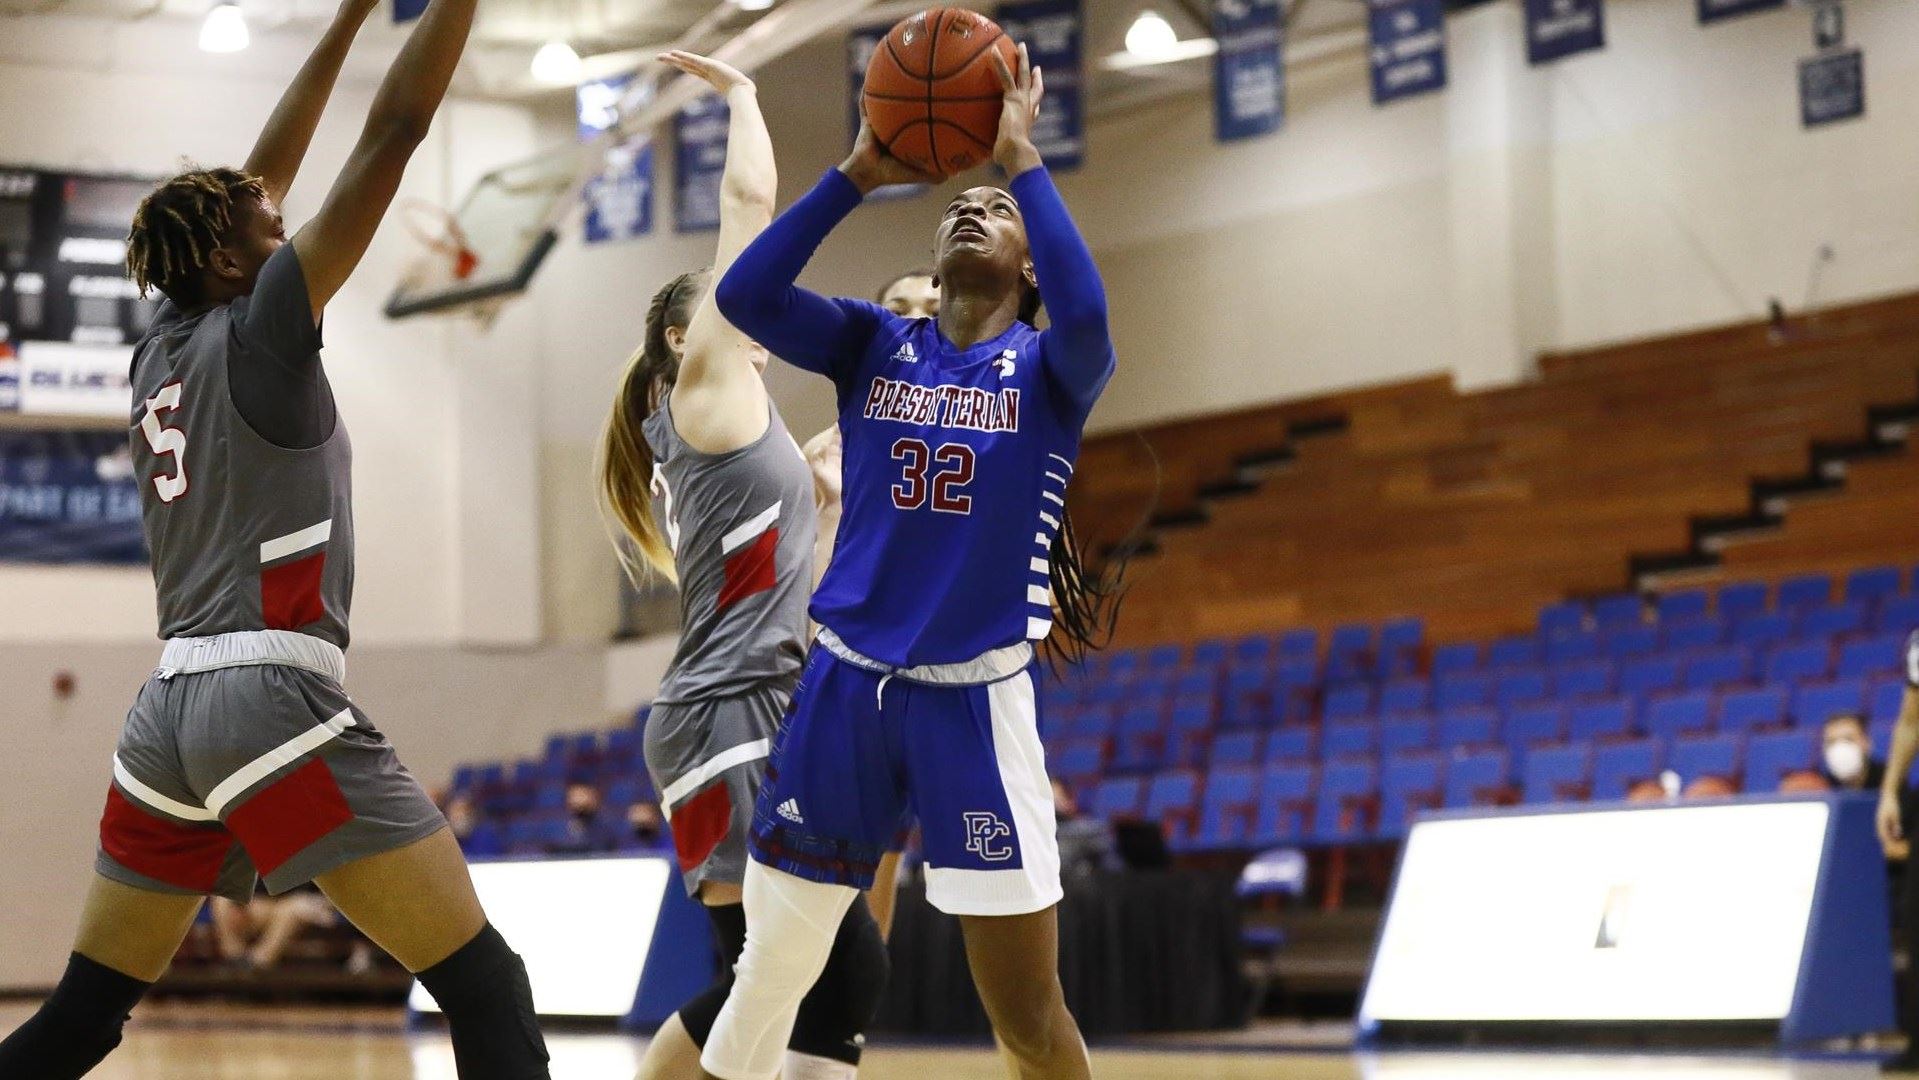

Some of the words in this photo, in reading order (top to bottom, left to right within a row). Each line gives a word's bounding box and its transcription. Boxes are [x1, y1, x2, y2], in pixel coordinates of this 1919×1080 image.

[863, 376, 1020, 433] PRESBYTERIAN
[140, 381, 188, 503] 5
[890, 437, 976, 516] 32
[776, 806, 804, 824] adidas
